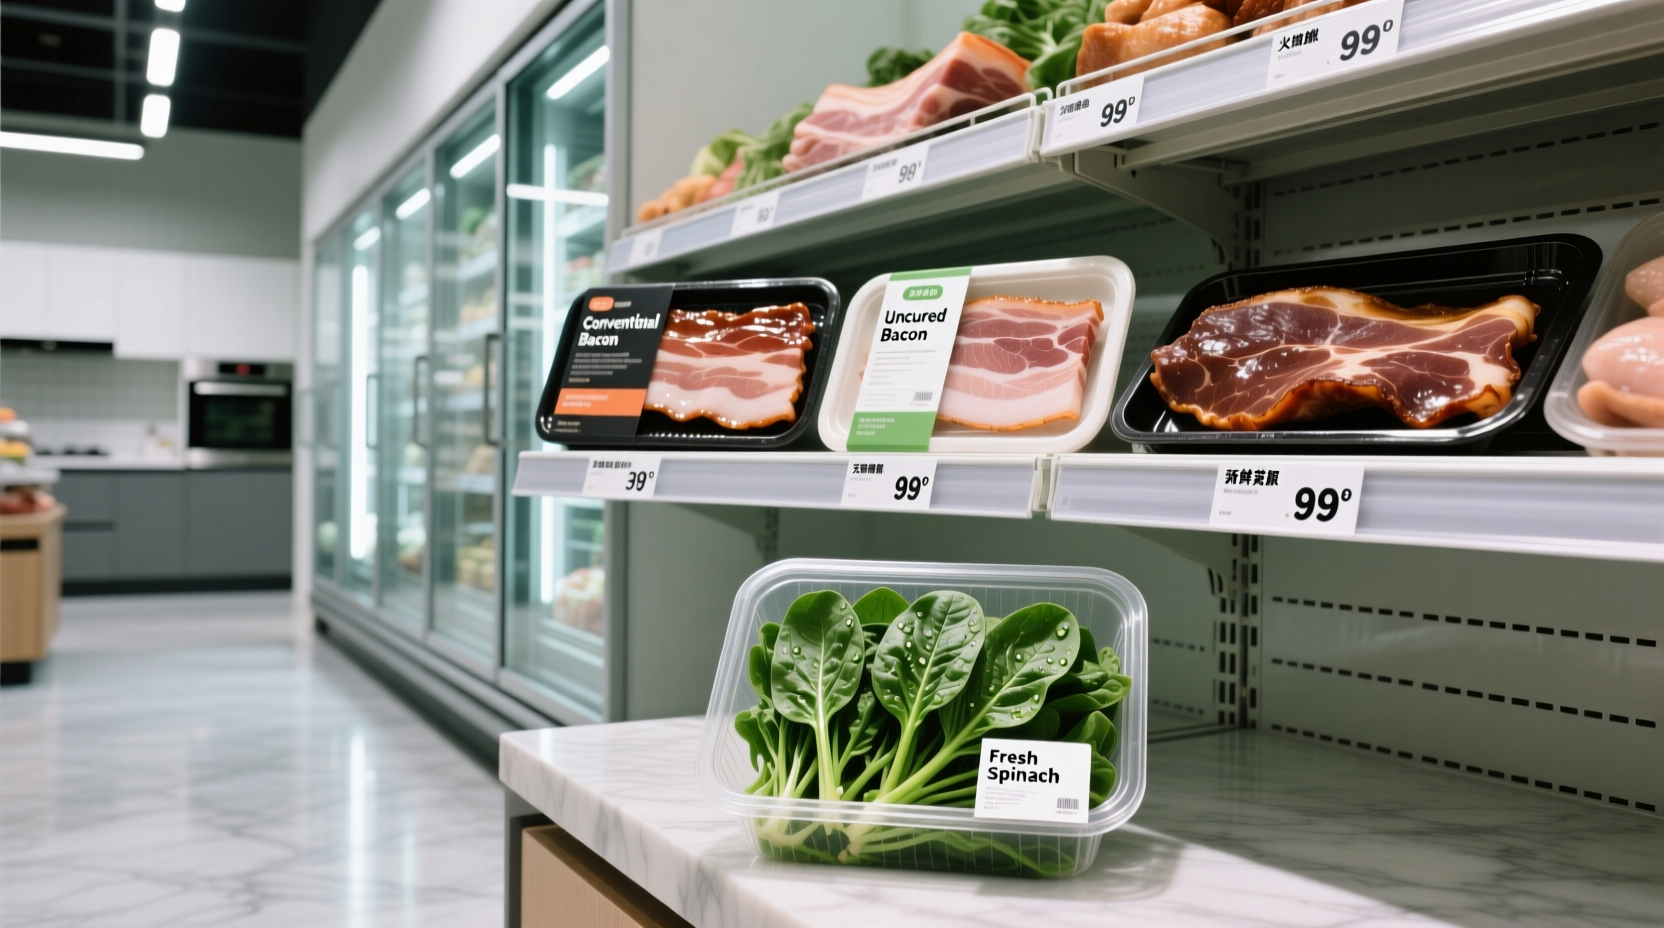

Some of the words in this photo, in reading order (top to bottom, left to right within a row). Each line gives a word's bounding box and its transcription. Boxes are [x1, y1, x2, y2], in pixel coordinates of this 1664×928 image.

[884, 307, 948, 324] Uncured
[578, 332, 619, 346] Bacon
[880, 328, 928, 342] Bacon
[989, 749, 1038, 766] Fresh
[987, 766, 1060, 785] Spinach
